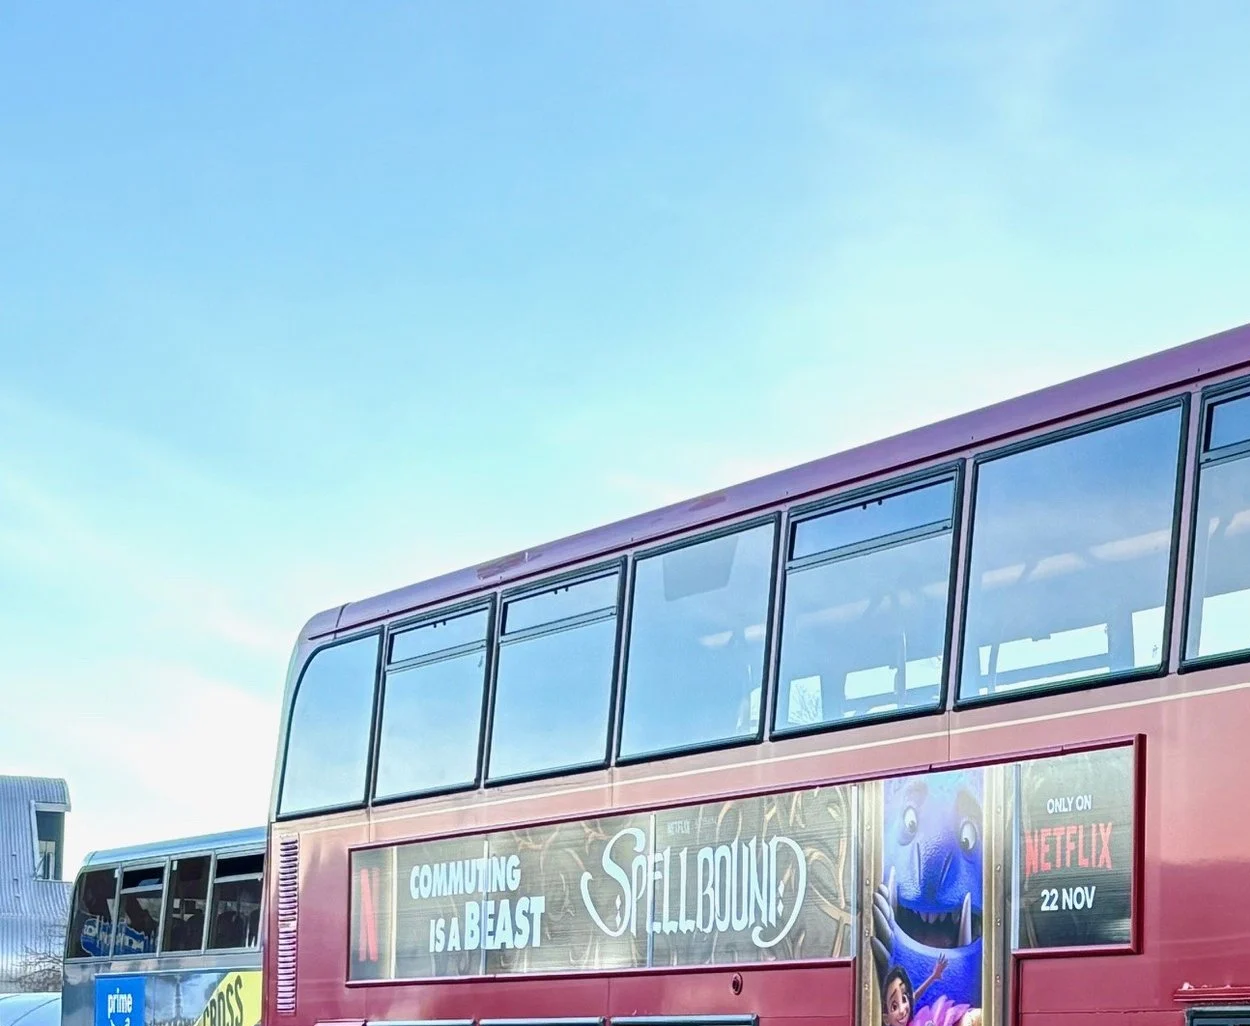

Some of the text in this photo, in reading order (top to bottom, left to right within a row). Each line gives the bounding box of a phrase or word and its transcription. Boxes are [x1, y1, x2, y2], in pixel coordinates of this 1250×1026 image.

[1046, 794, 1092, 814] ONLY ON
[1024, 822, 1113, 878] NETFLIX
[410, 854, 522, 900] COMMUTING
[580, 827, 807, 948] SPELLBOUND
[1040, 885, 1097, 912] 22 NOV
[429, 895, 546, 953] IS A BEAST
[107, 987, 133, 1018] prime
